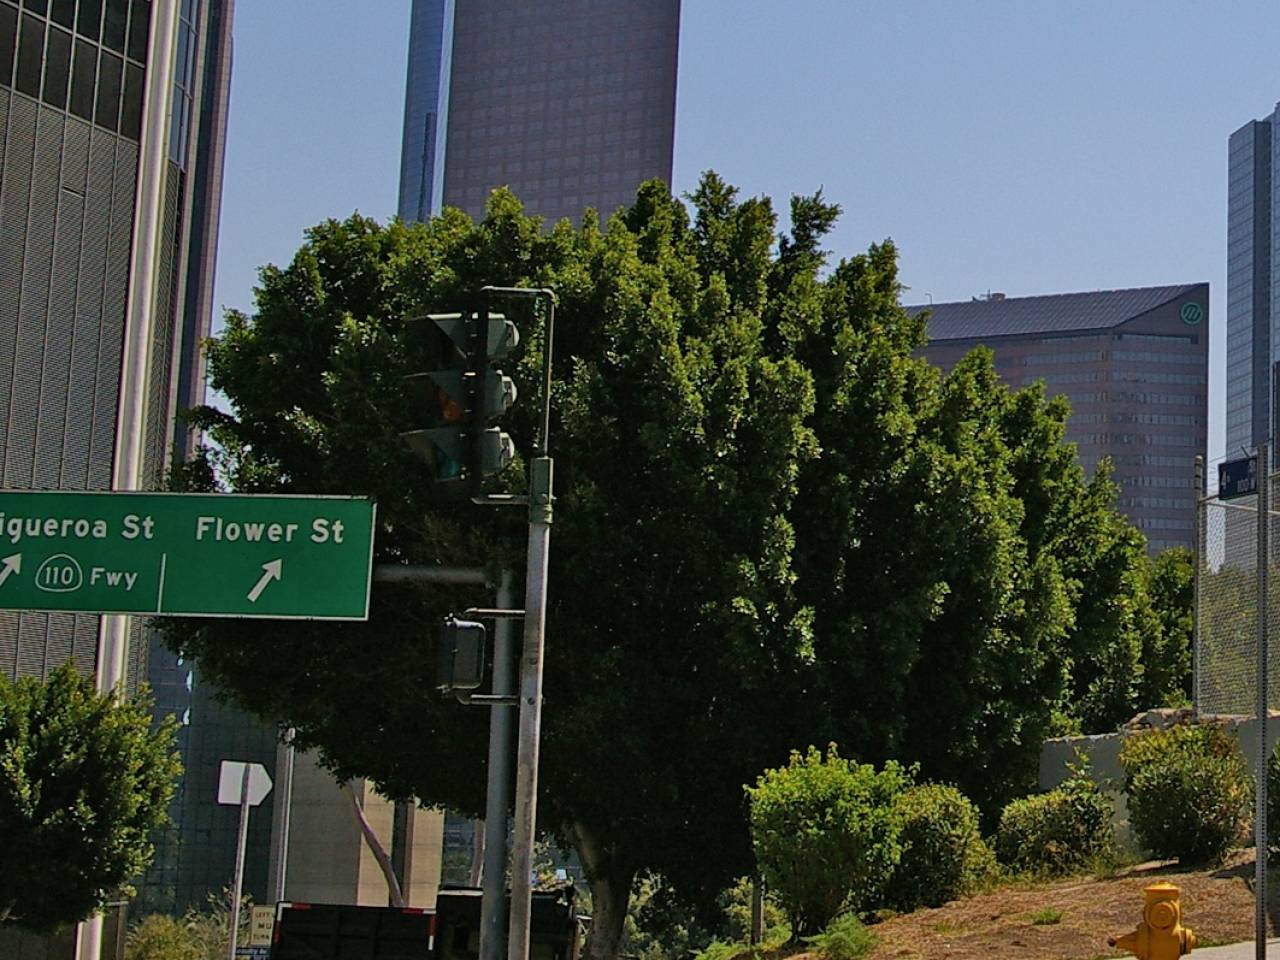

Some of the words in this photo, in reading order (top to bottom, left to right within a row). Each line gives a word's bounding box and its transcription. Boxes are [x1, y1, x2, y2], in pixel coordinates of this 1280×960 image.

[121, 514, 155, 540] St
[195, 516, 299, 543] Flower
[310, 518, 345, 544] St
[44, 565, 74, 586] 110
[89, 567, 138, 591] Fwy
